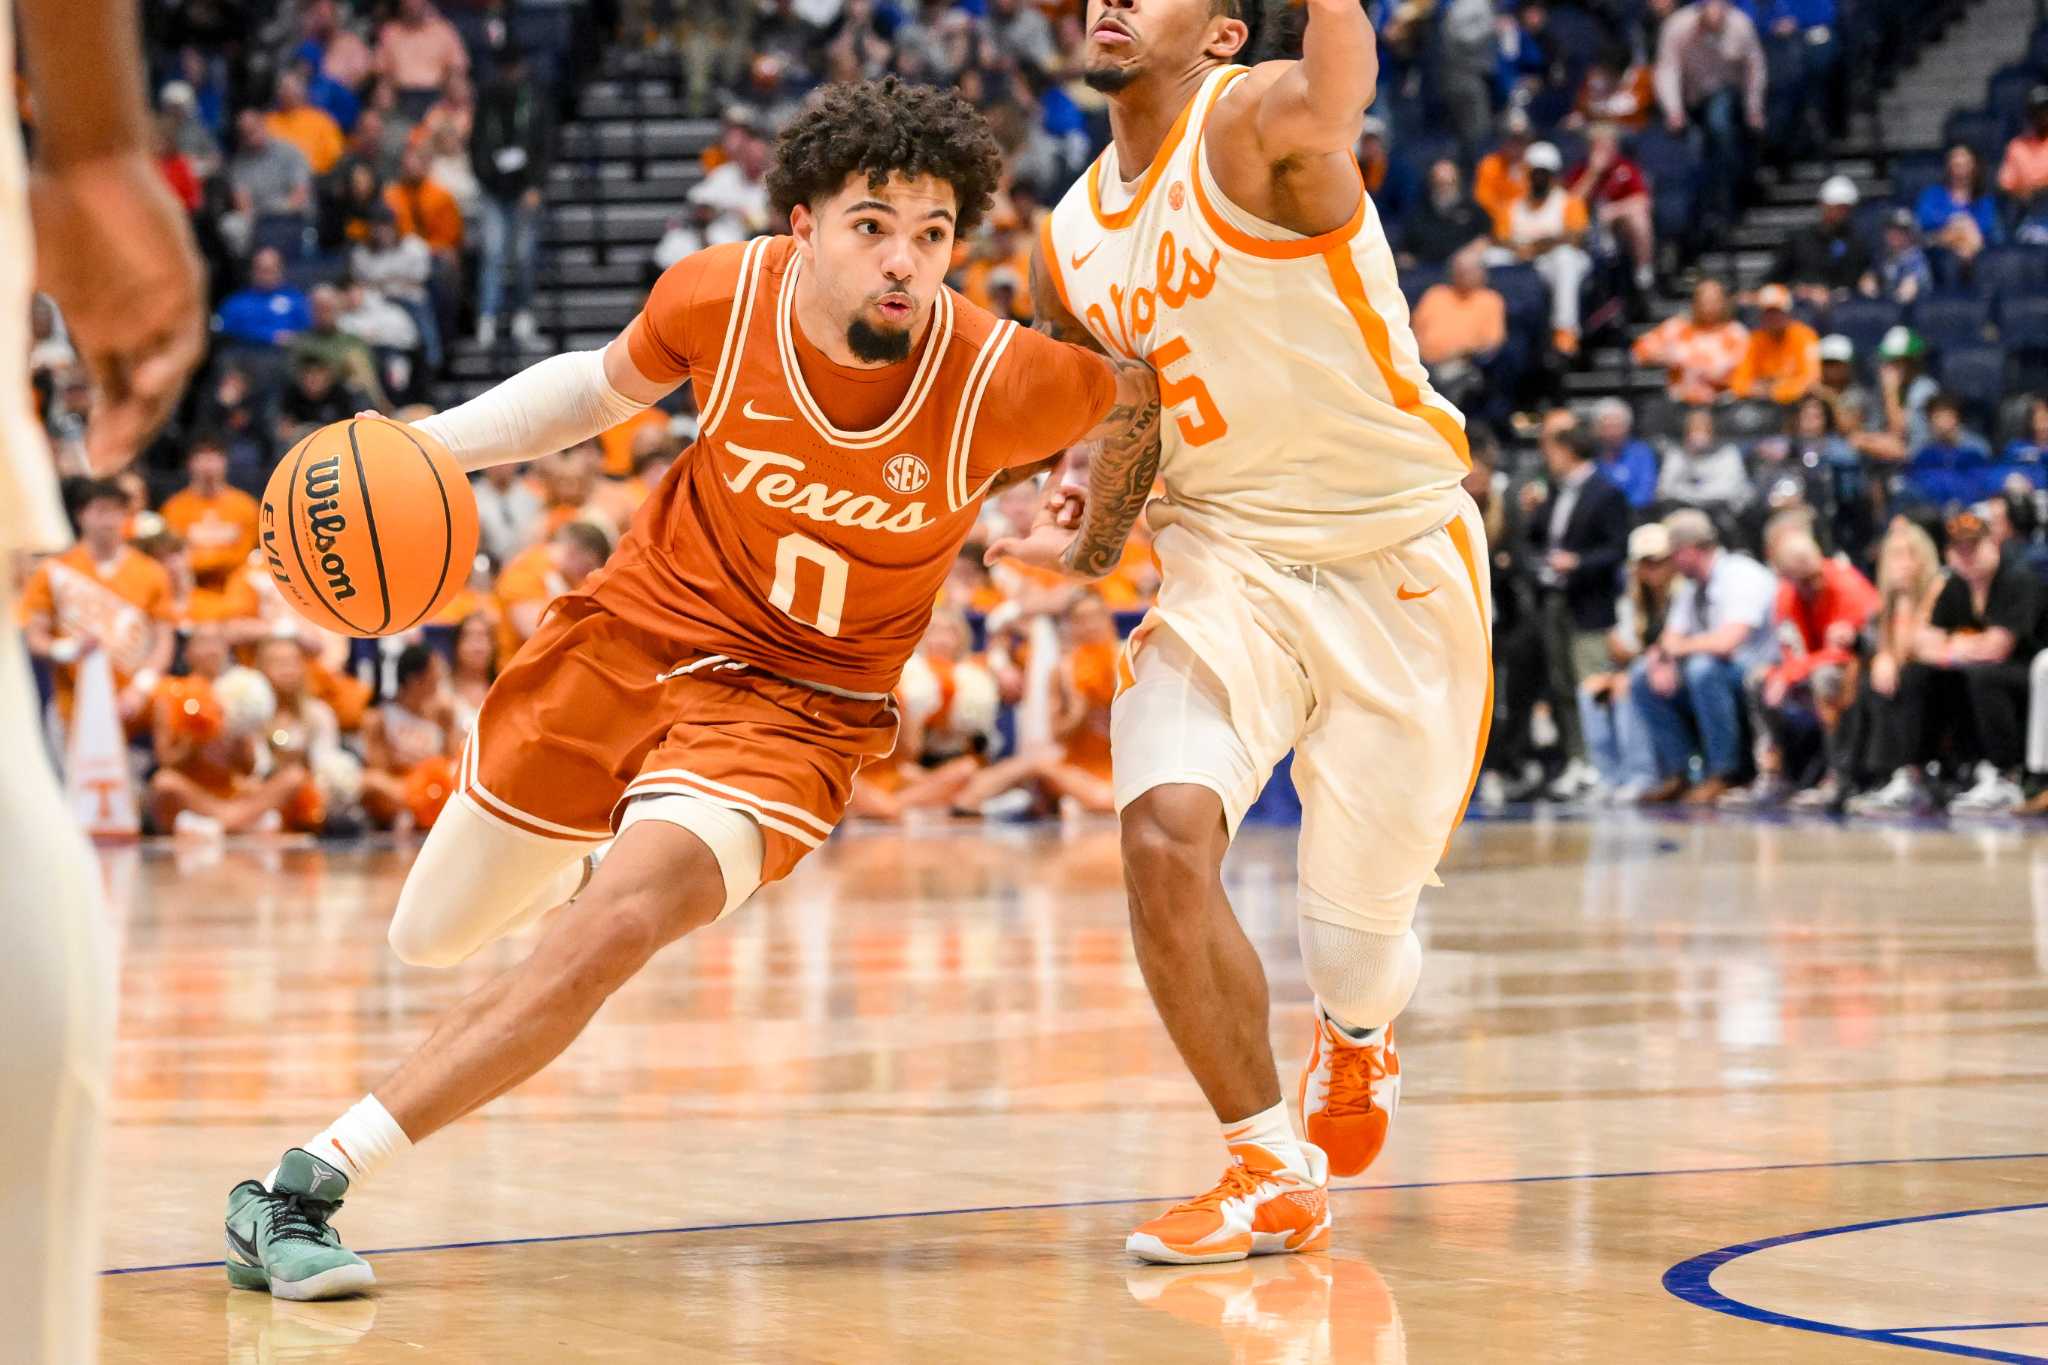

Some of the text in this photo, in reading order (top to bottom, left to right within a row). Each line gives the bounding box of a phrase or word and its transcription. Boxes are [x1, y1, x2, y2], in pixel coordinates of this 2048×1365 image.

[1145, 336, 1229, 447] 5
[723, 441, 937, 533] Texas
[887, 456, 929, 493] SEC
[304, 454, 357, 602] Wilson
[768, 532, 849, 638] 0
